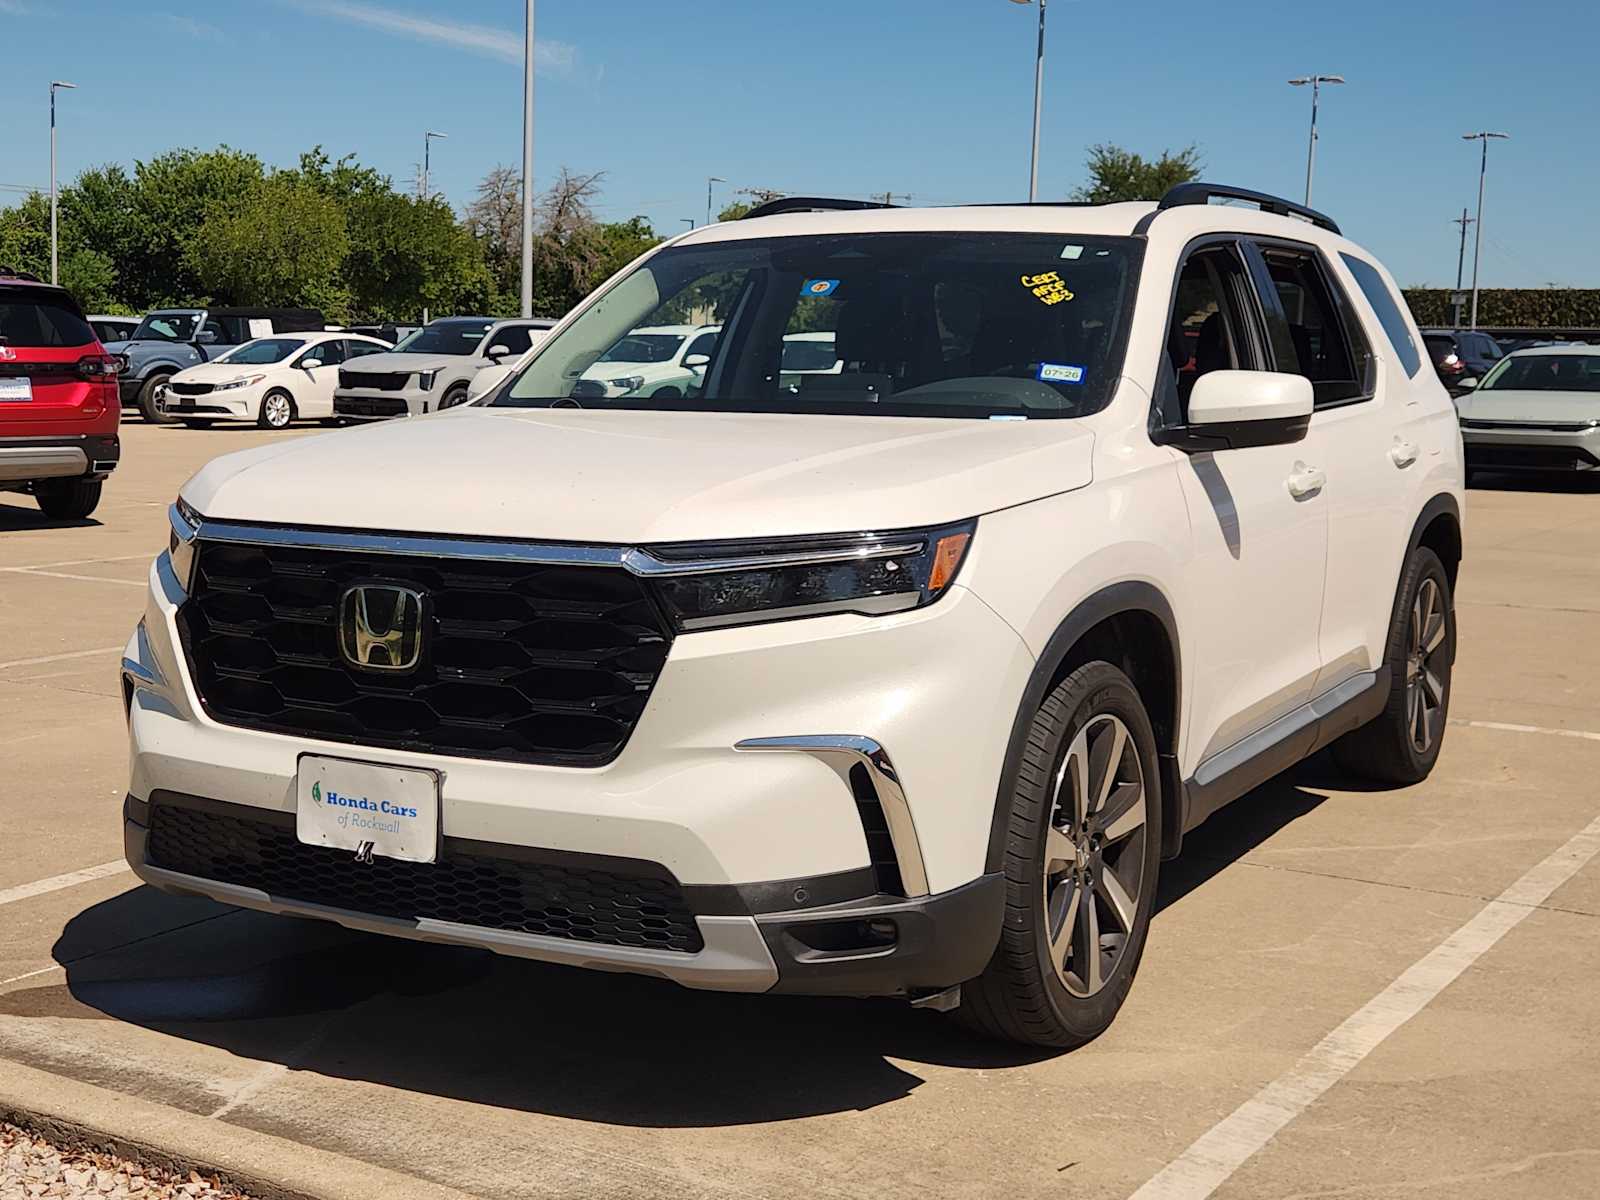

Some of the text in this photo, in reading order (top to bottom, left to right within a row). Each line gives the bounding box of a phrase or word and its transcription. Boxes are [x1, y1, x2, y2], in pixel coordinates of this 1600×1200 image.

[326, 792, 417, 818] Honda Cars
[337, 811, 400, 834] of Rockwall
